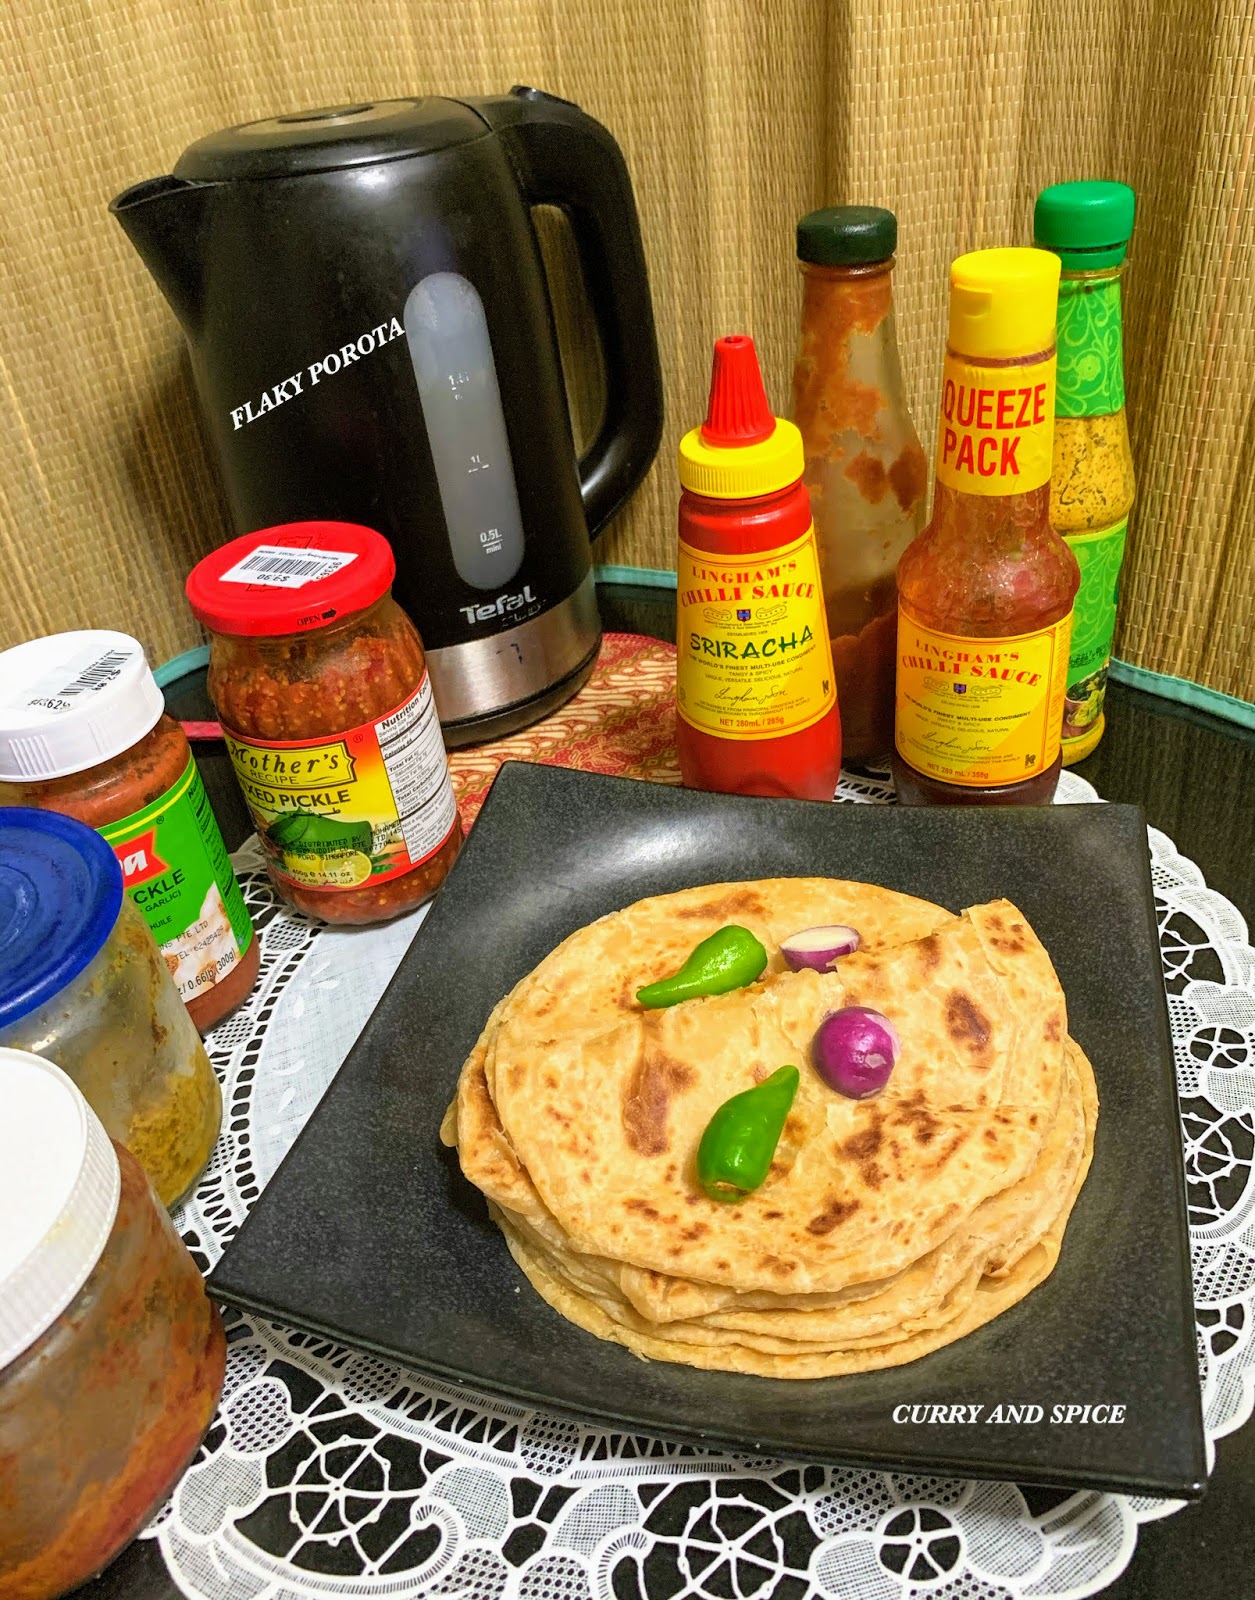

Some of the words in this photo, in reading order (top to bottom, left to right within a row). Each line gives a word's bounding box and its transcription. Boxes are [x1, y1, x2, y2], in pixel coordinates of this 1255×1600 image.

[942, 379, 1046, 430] QUEEZE
[943, 427, 1021, 477] PACK
[480, 528, 502, 543] 0.5L
[692, 560, 797, 584] LINGHAM'S
[459, 585, 537, 625] Tefal
[681, 587, 743, 608] CHILLI
[752, 582, 815, 600] SAUCE
[297, 614, 320, 626] OPEN
[690, 624, 813, 660] SRIRACHA
[915, 639, 1019, 663] LINGHAM'S
[750, 659, 785, 670] MULTI-USE
[902, 655, 961, 674] CHILLI
[970, 665, 1042, 687] SAUCE
[381, 697, 420, 730] Nutrition
[719, 717, 734, 727] NET
[993, 710, 1032, 722] CONDIMENT
[229, 741, 339, 774] Mother's
[927, 762, 940, 772] NET
[249, 769, 300, 785] RECIPE
[279, 789, 352, 808] PICKLE
[320, 850, 360, 861] SINGAPORE
[129, 868, 186, 905] CKLE
[145, 890, 182, 913] GARLIC)
[150, 915, 173, 931] HUILE
[176, 930, 193, 943] PTE
